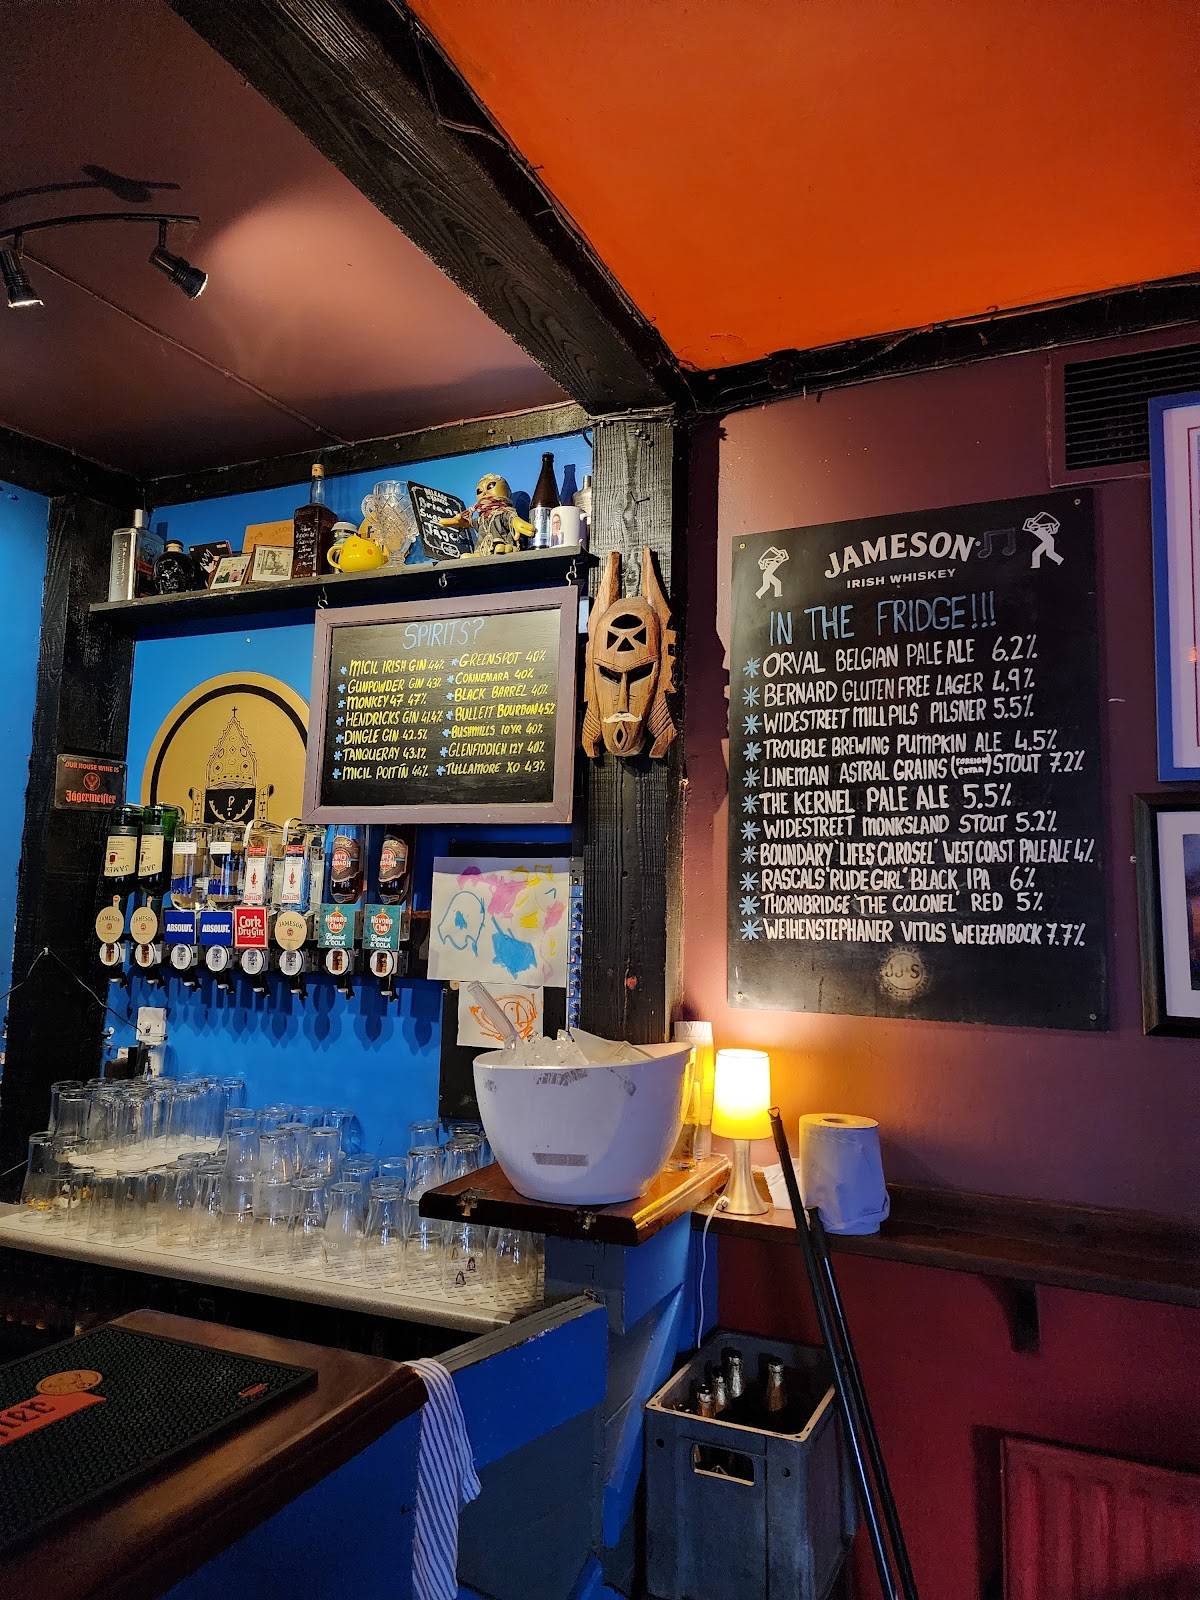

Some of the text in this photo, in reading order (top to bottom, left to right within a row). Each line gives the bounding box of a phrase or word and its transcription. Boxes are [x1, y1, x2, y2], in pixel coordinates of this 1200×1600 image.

[824, 531, 976, 579] JAMESON
[847, 569, 956, 589] IRISH WHISKEY
[769, 591, 997, 646] IN THE FRIDGE!!!
[402, 618, 485, 650] SPIRITS?
[382, 658, 407, 673] IRISH
[409, 658, 427, 672] GIN
[762, 634, 1038, 678] ORVAL BELGIAN PALE ALE 6.2%
[347, 678, 404, 695] GUNPOWDER
[408, 676, 424, 689] GIN
[455, 668, 534, 685] CONNEMARA 40%
[454, 689, 486, 702] BLACK
[492, 684, 527, 698] BARREL
[763, 668, 1035, 707] BERNARD GLUTEN FREE LAGER 4.9%
[346, 694, 389, 712] MONKEY
[407, 693, 427, 705] 47%
[345, 711, 400, 727] HENDRICKS
[402, 709, 420, 724] GIN
[455, 705, 495, 722] BULLEIT
[497, 703, 538, 718] BOURBON
[762, 710, 851, 735] WIDESTREET
[930, 699, 987, 724] PILSNER
[993, 694, 1034, 720] 5.5%
[343, 729, 428, 746] DINGLE GIN 42.5%
[451, 724, 496, 739] BUSHMILLS
[526, 723, 543, 735] 40%
[342, 747, 427, 761] TANQUERAY 43.1%
[448, 742, 507, 757] GLENFIDDICH
[763, 729, 1057, 760] TROUBLE BREWING PUMPKIN ALE 4.5%
[64, 761, 78, 769] OUR
[79, 763, 98, 771] HOUSE
[98, 765, 114, 773] WINE
[445, 761, 546, 775] TULLAMORE XO 43%
[763, 765, 829, 788] LINEMAN
[839, 760, 890, 784] ASTRAL
[892, 757, 948, 782] GRAINS
[993, 753, 1041, 775] STOUT
[1049, 750, 1085, 773] 7.2%
[759, 783, 1012, 815] THE KERNEL PALE ALE 5.5%
[762, 810, 1058, 839] WIDESTREET MONKSLAND STOUT 5.2%
[760, 842, 833, 867] BOUNDARY
[1074, 838, 1095, 864] 4%
[761, 868, 825, 892] RASCALS
[910, 868, 958, 891] BLACK
[966, 867, 991, 891] IPA
[1009, 866, 1036, 891] 6%
[761, 893, 851, 915] THORNBRIDGE
[971, 892, 1003, 912] RED
[1016, 892, 1043, 912] 5%
[239, 915, 262, 928] Cork
[279, 920, 303, 930] JAMESON
[238, 927, 264, 938] Dry Gin
[762, 917, 1086, 947] WEIHENSTEPHANER VITUS WEIZENBOCK 7.7%
